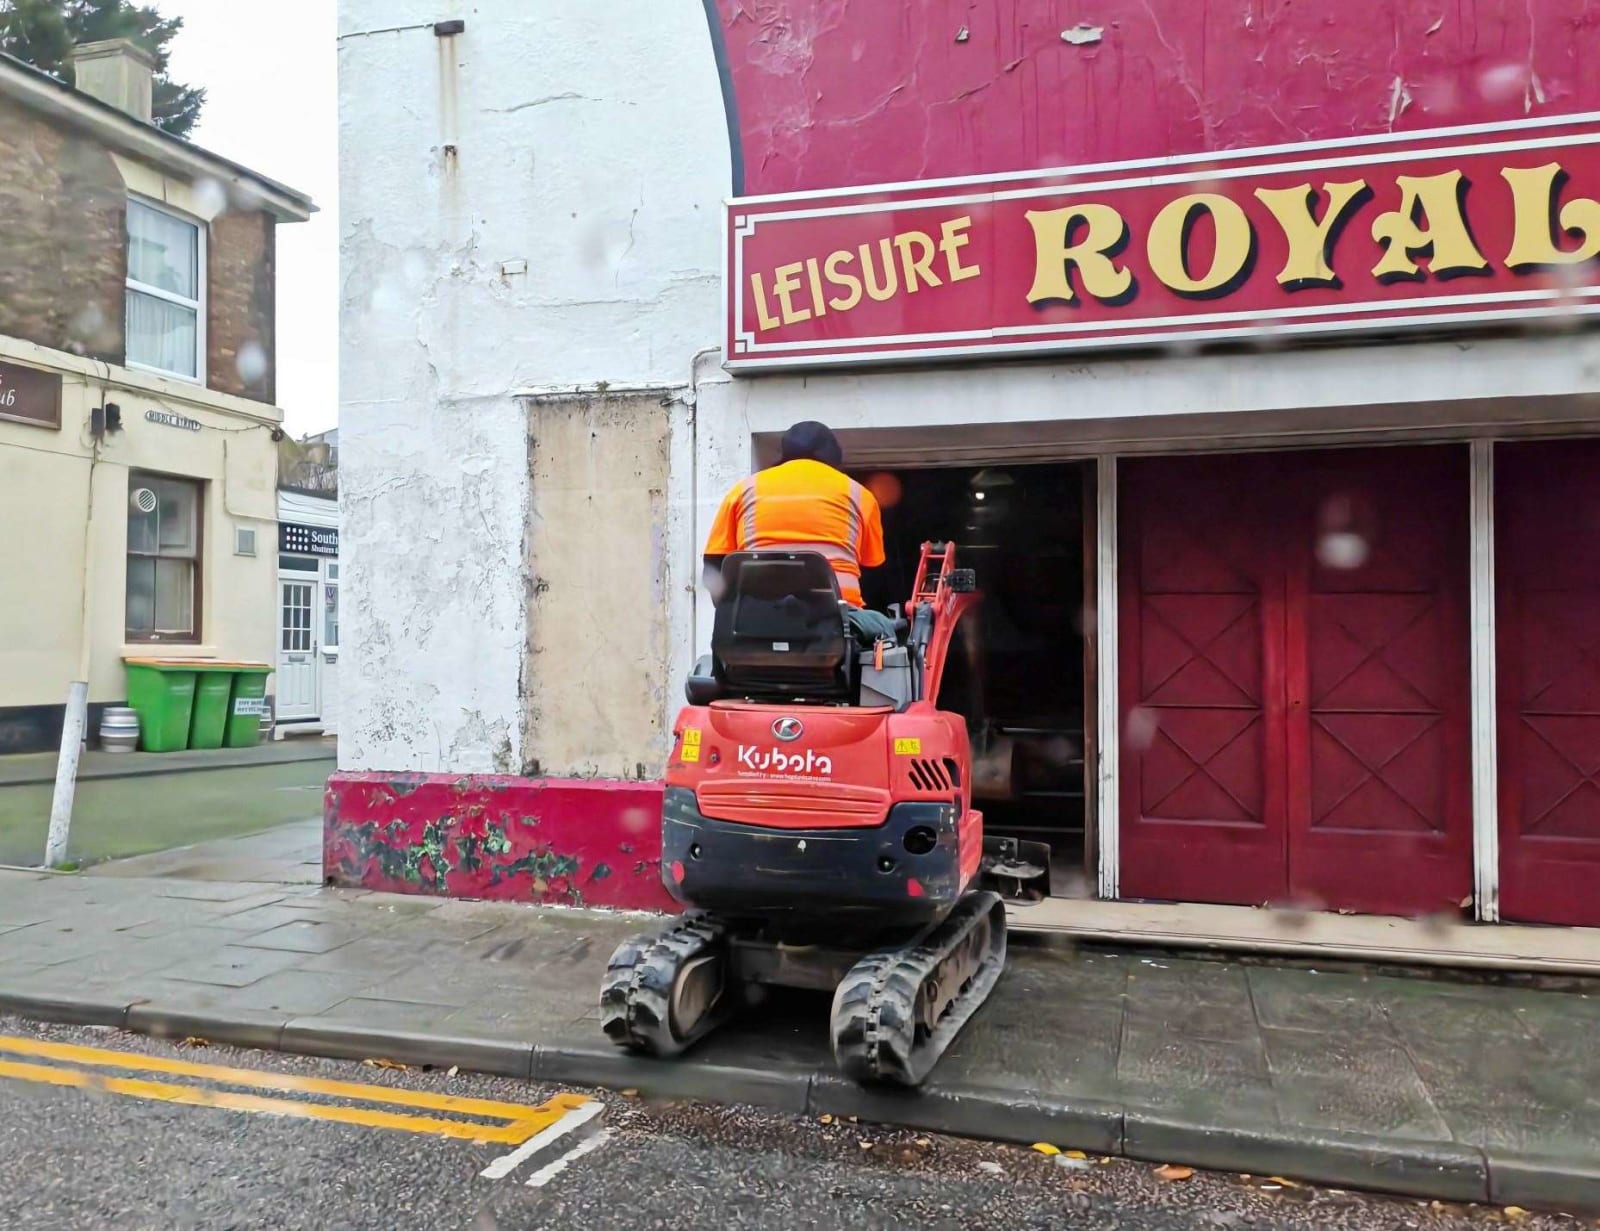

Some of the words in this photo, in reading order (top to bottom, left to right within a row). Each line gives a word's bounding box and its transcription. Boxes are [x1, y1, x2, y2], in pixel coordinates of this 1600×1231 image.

[1024, 161, 1600, 304] ROYAL
[750, 215, 981, 331] LEISURE
[311, 531, 338, 544] South
[738, 745, 832, 773] Kubota
